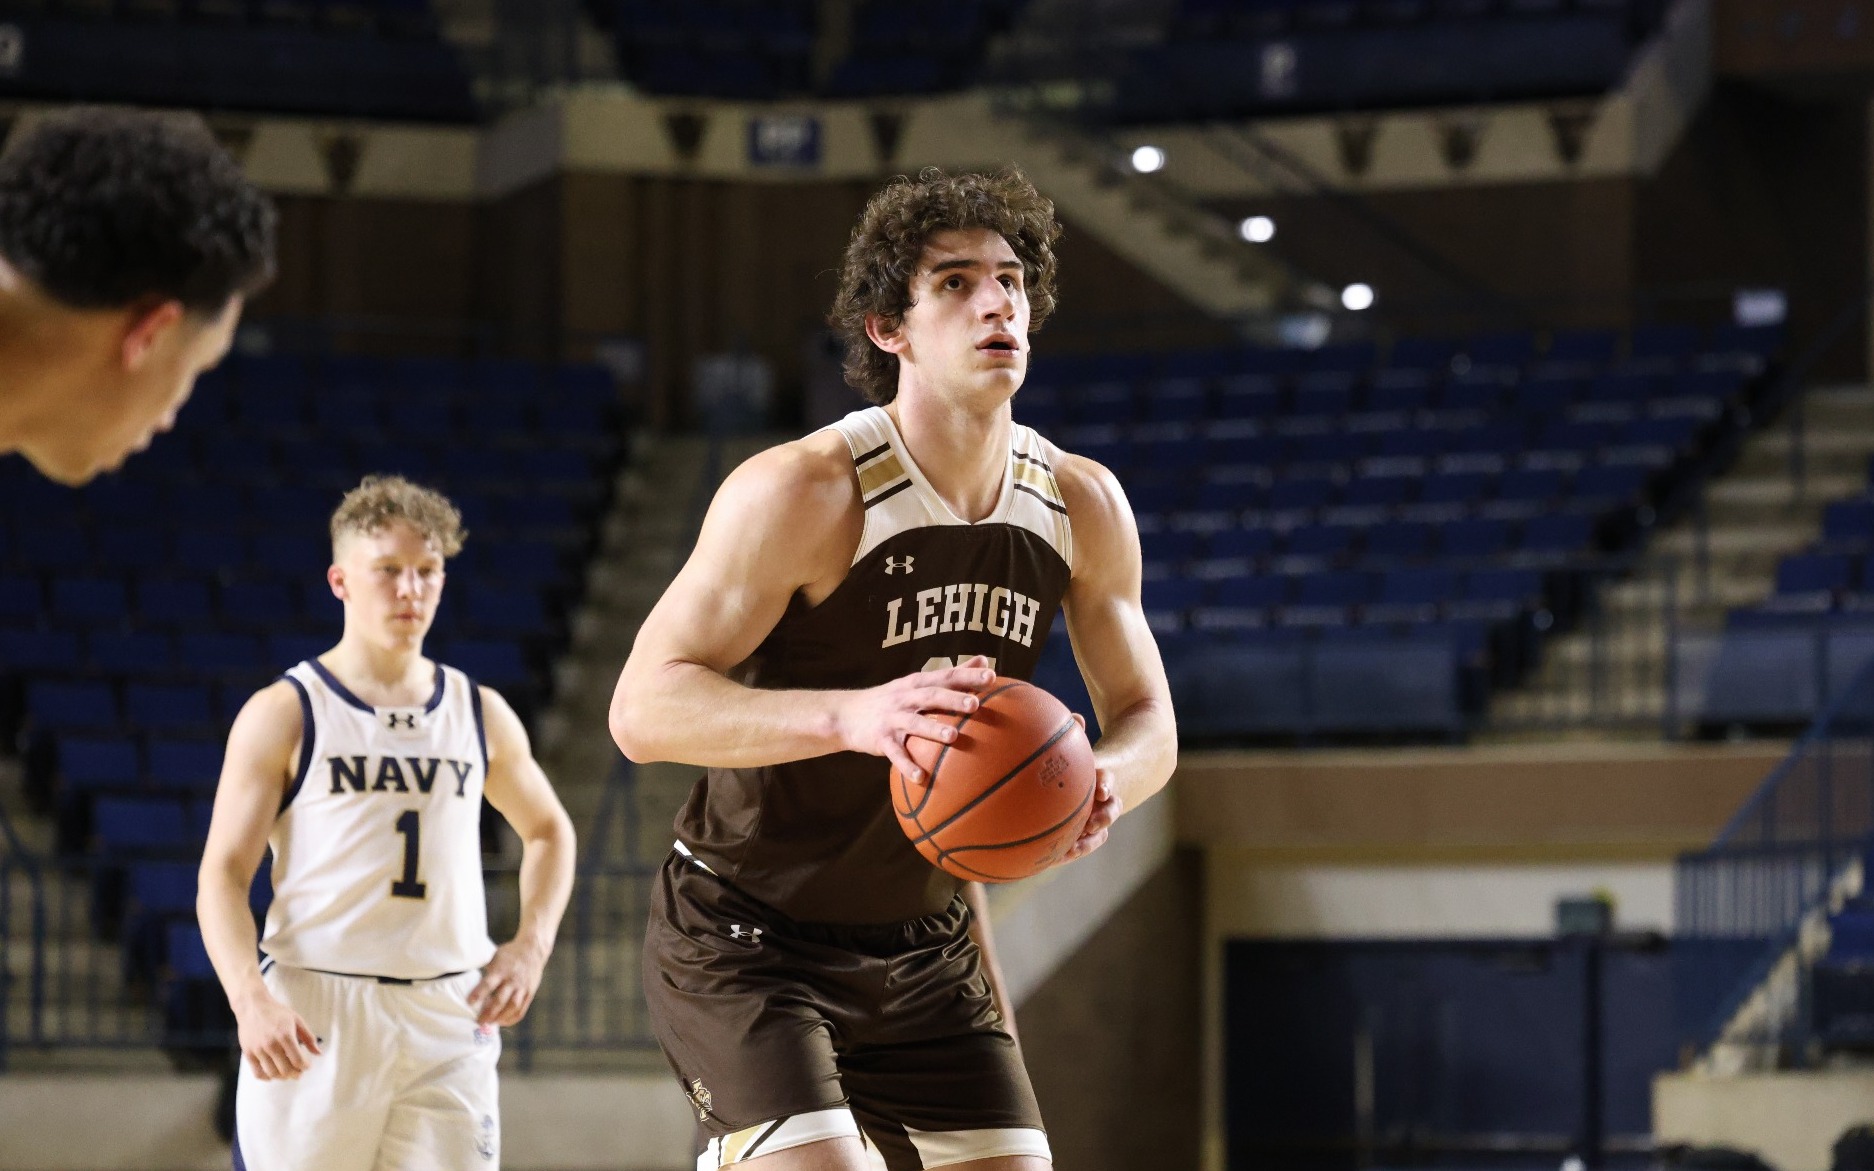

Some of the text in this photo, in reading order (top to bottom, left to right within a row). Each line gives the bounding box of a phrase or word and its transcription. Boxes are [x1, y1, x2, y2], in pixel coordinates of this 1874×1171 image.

[881, 583, 1041, 649] LEHIGH
[327, 755, 472, 797] NAVY
[391, 810, 426, 899] 1
